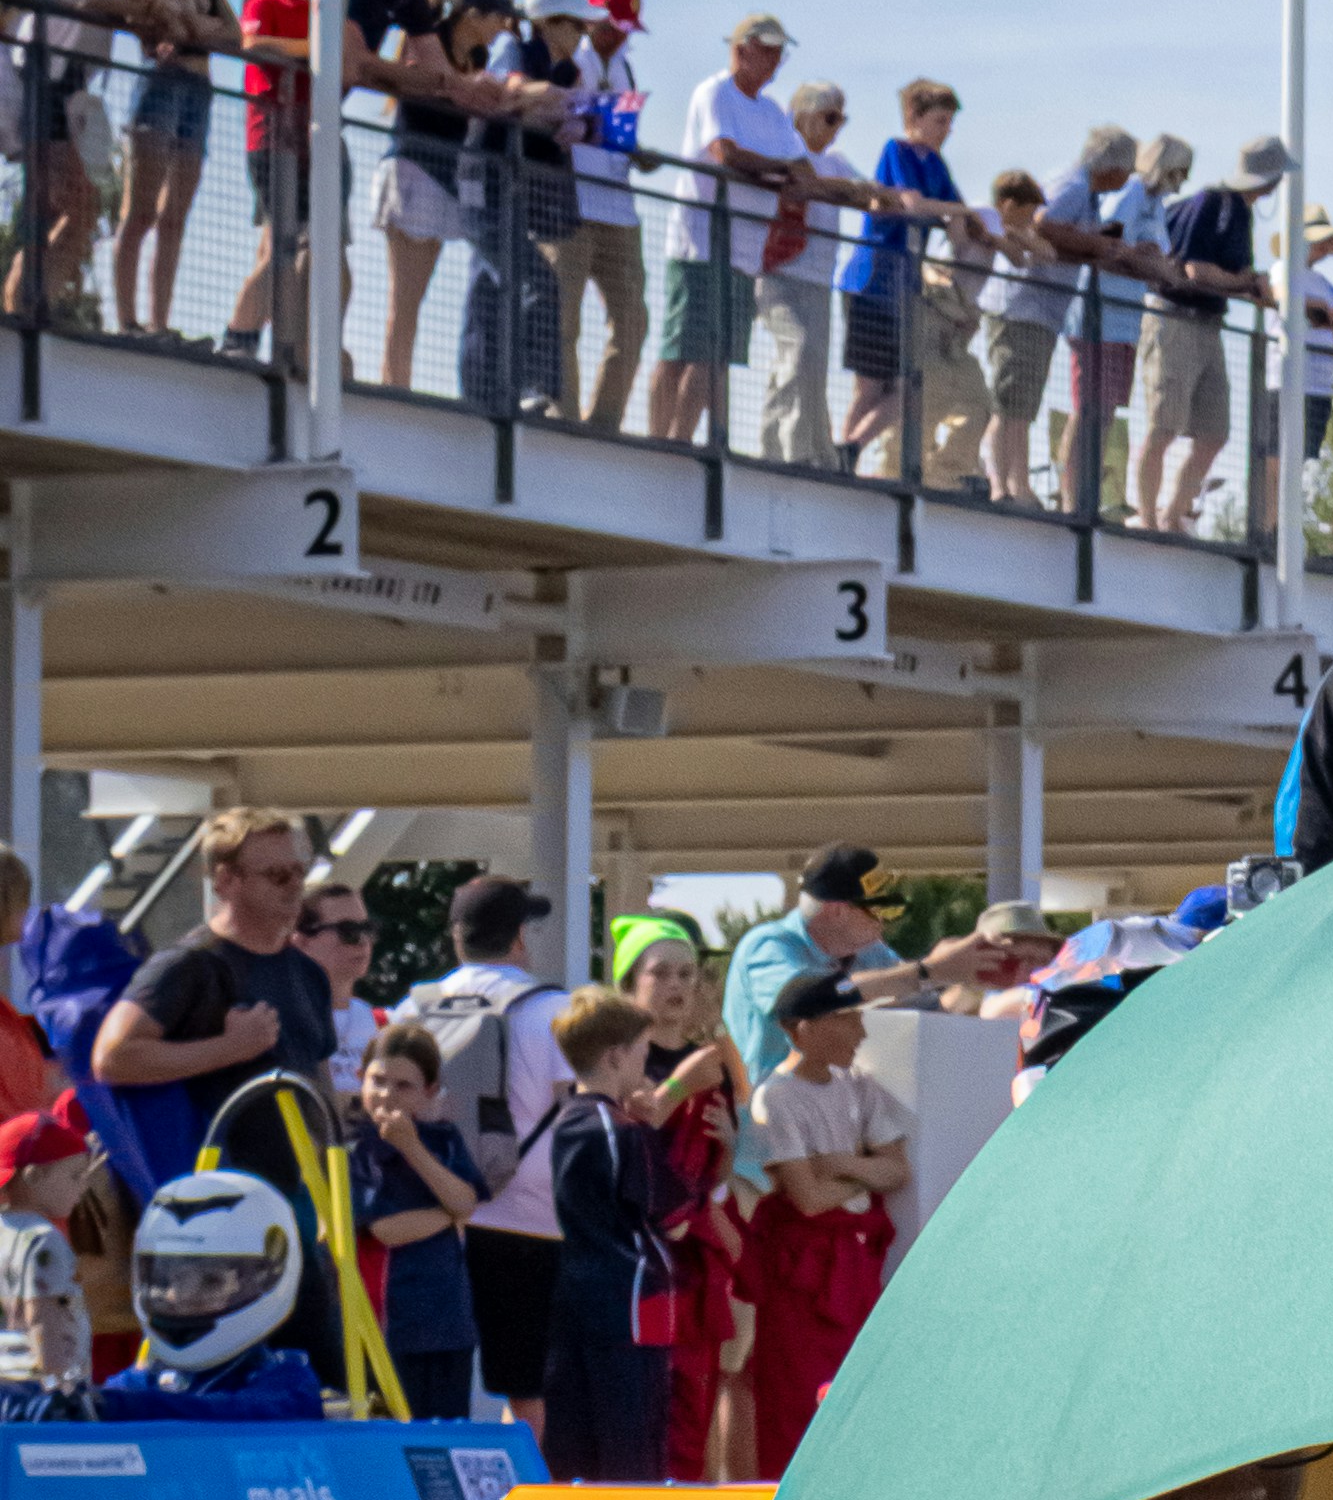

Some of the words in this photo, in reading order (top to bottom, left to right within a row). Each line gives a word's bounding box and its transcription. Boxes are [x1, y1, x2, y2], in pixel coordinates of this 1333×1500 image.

[304, 491, 342, 557] 2
[834, 581, 868, 641] 3
[1274, 653, 1309, 707] 4
